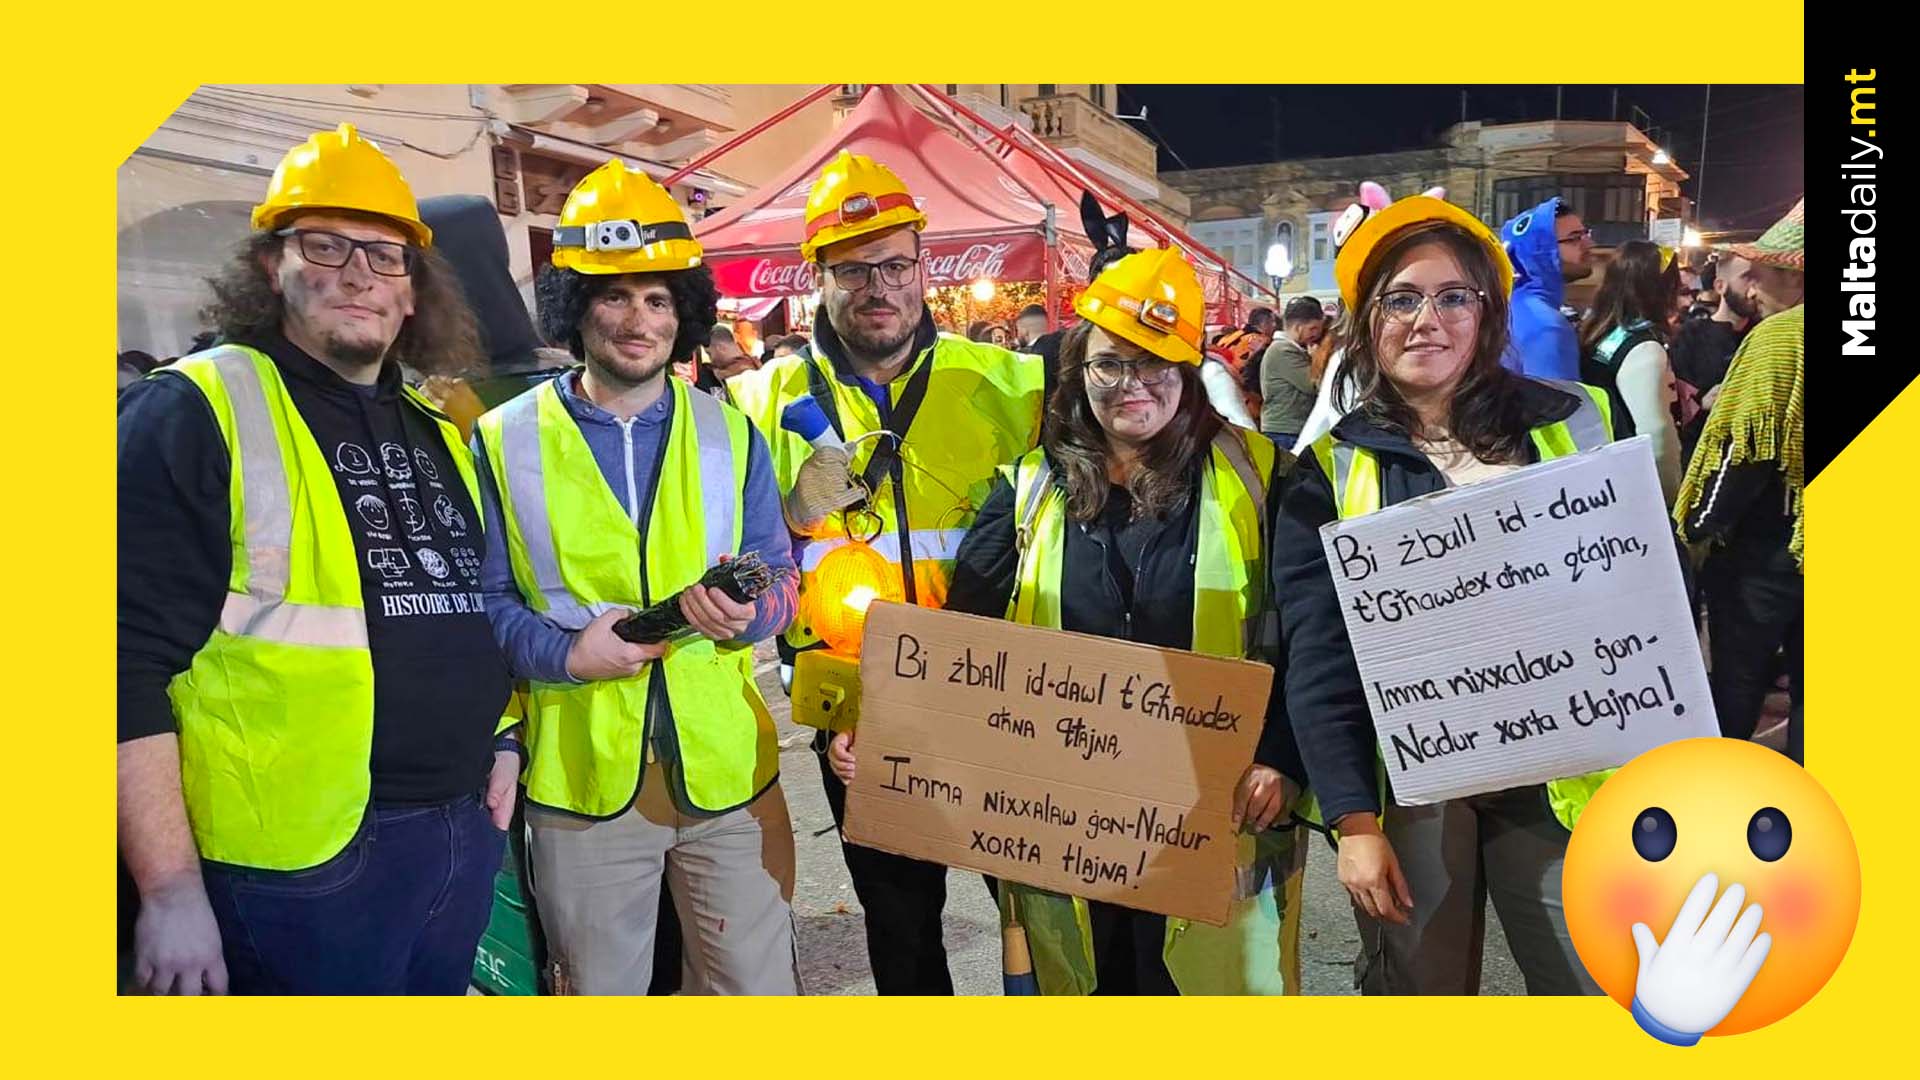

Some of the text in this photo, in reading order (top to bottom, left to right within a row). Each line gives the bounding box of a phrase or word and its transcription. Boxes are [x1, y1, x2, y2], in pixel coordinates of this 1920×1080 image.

[1333, 533, 1378, 580] Bi
[1399, 512, 1476, 566] żball
[381, 592, 453, 617] HISTOIRE
[450, 592, 470, 613] DE
[894, 633, 928, 680] Bi
[1374, 678, 1443, 712] Imma
[1448, 650, 1574, 696] nixxalaw
[1391, 665, 1685, 771] Nadur xorta tlajna!
